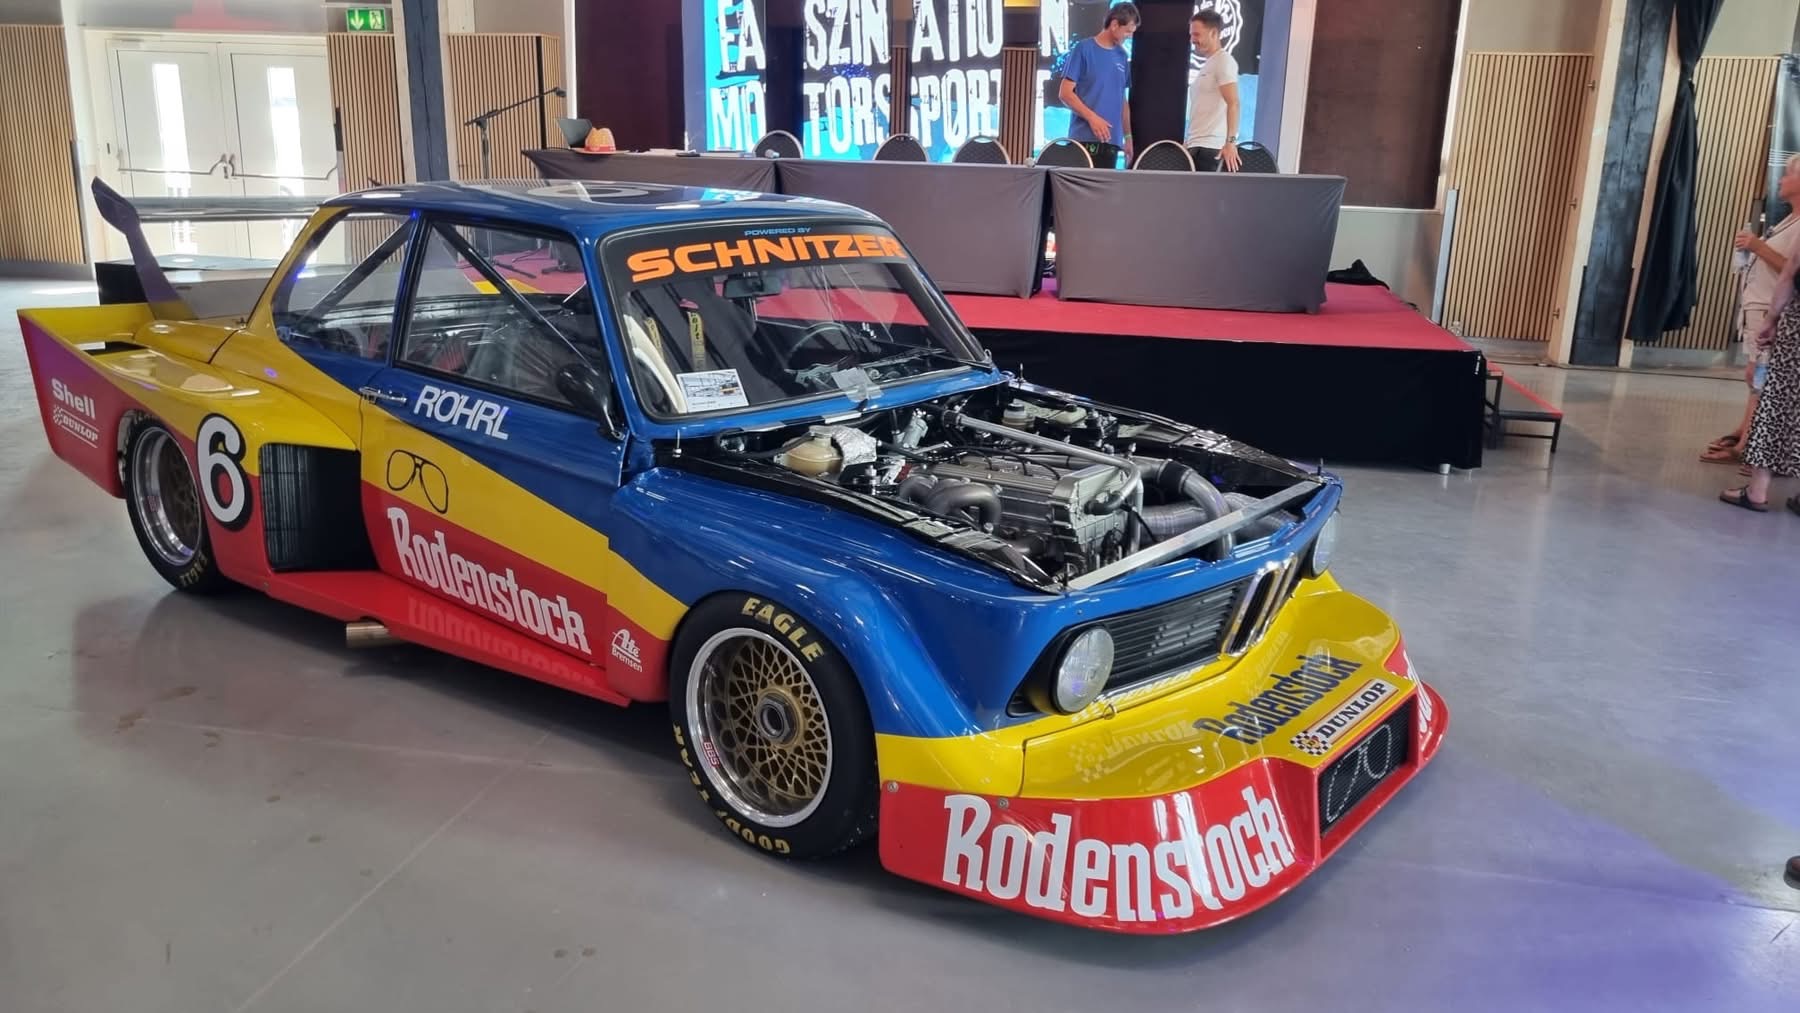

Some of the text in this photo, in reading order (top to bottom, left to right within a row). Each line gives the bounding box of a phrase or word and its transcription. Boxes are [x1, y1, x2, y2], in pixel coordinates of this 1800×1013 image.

[626, 234, 907, 283] SCHNITZER
[744, 228, 796, 236] POWERED
[51, 378, 96, 419] Shell
[413, 384, 510, 441] RÖHRL
[63, 416, 98, 442] DUNLOP
[197, 416, 246, 522] 6
[387, 506, 592, 655] Rodenstock
[742, 597, 824, 663] EAGLE
[612, 646, 643, 673] Bremsen
[1192, 654, 1363, 745] Rodenstock
[1315, 682, 1389, 739] DUNLOP
[703, 740, 720, 768] BBS
[942, 785, 1296, 923] Rodenstock
